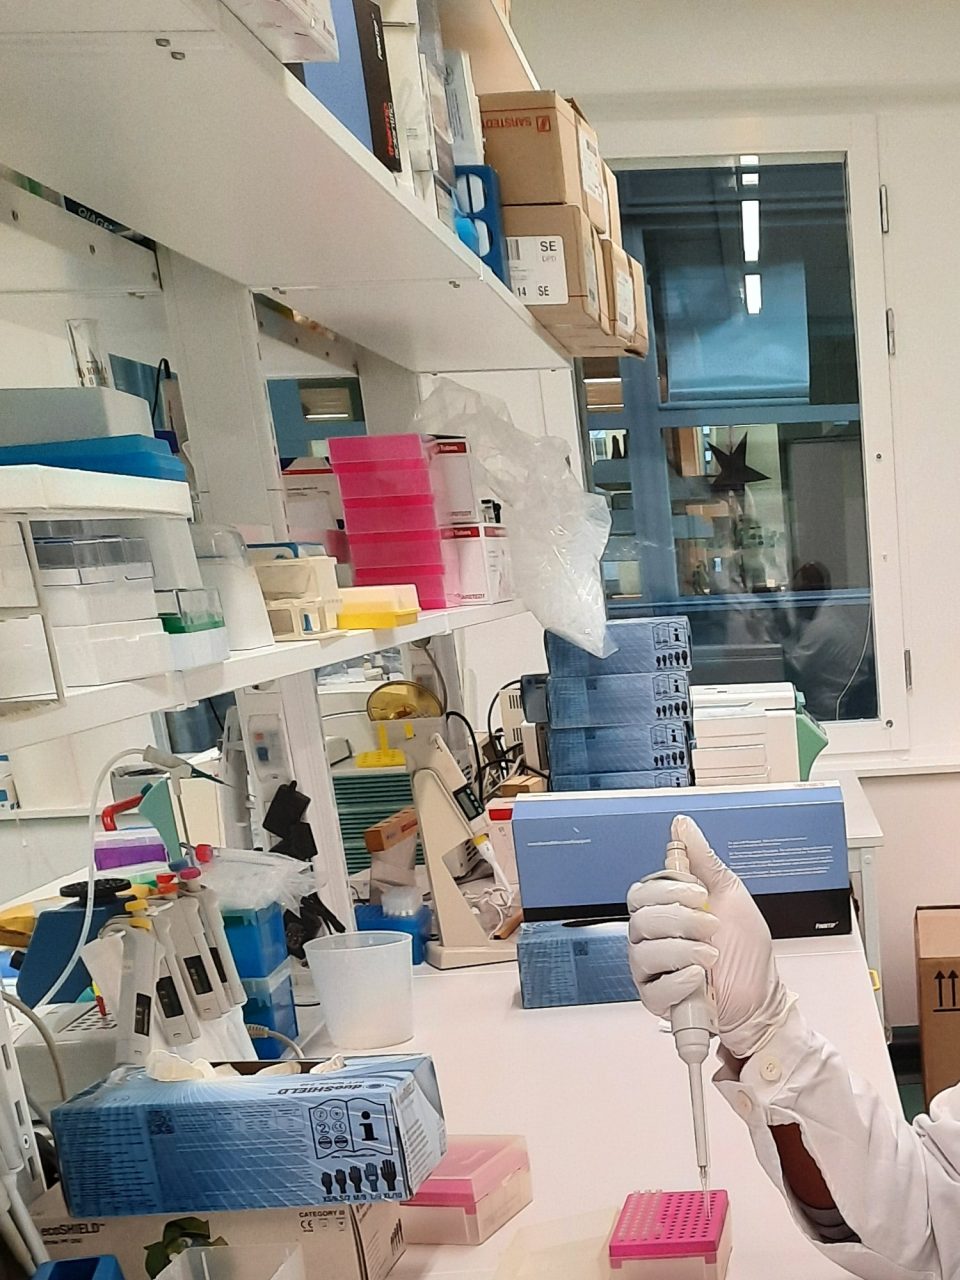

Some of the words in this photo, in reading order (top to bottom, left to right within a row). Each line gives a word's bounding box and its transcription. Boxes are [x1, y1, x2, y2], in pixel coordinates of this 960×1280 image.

[540, 240, 557, 252] SE
[517, 286, 527, 297] 14
[538, 285, 550, 297] SE
[299, 1210, 337, 1218] CATEGORY
